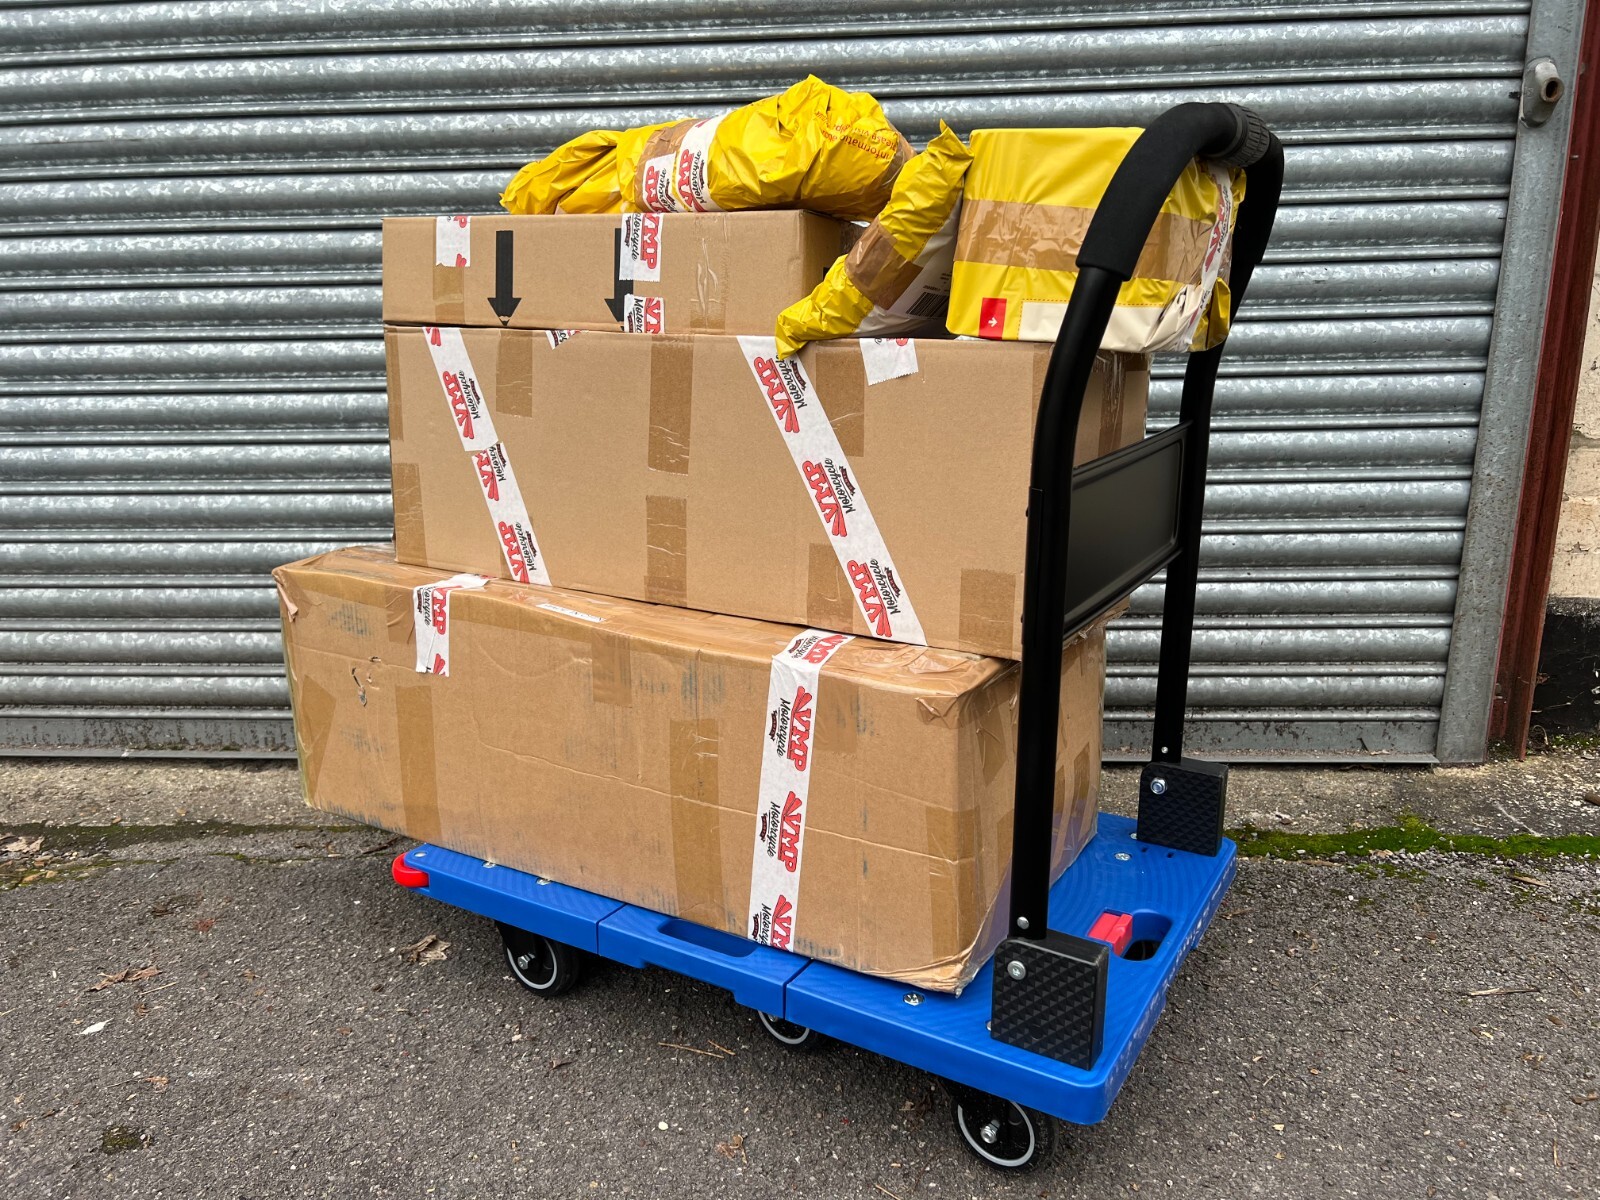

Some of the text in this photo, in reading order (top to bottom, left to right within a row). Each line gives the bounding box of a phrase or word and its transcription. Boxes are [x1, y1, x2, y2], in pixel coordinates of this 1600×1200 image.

[633, 298, 643, 334] Motorc
[443, 371, 470, 426] VMP
[458, 370, 481, 420] Motorcycle
[754, 356, 792, 420] VMP
[490, 446, 507, 482] Motorcy
[802, 460, 839, 524] VMP
[824, 457, 856, 514] Motorcycle
[498, 521, 526, 577] VMP
[515, 522, 537, 571] Motorcycle
[847, 560, 883, 624] VMP
[870, 558, 901, 615] Motorcycle
[777, 697, 791, 758] Motorcycle
[787, 708, 812, 772] VMP
[766, 801, 781, 858] Motorcycle
[777, 813, 802, 873] VMP
